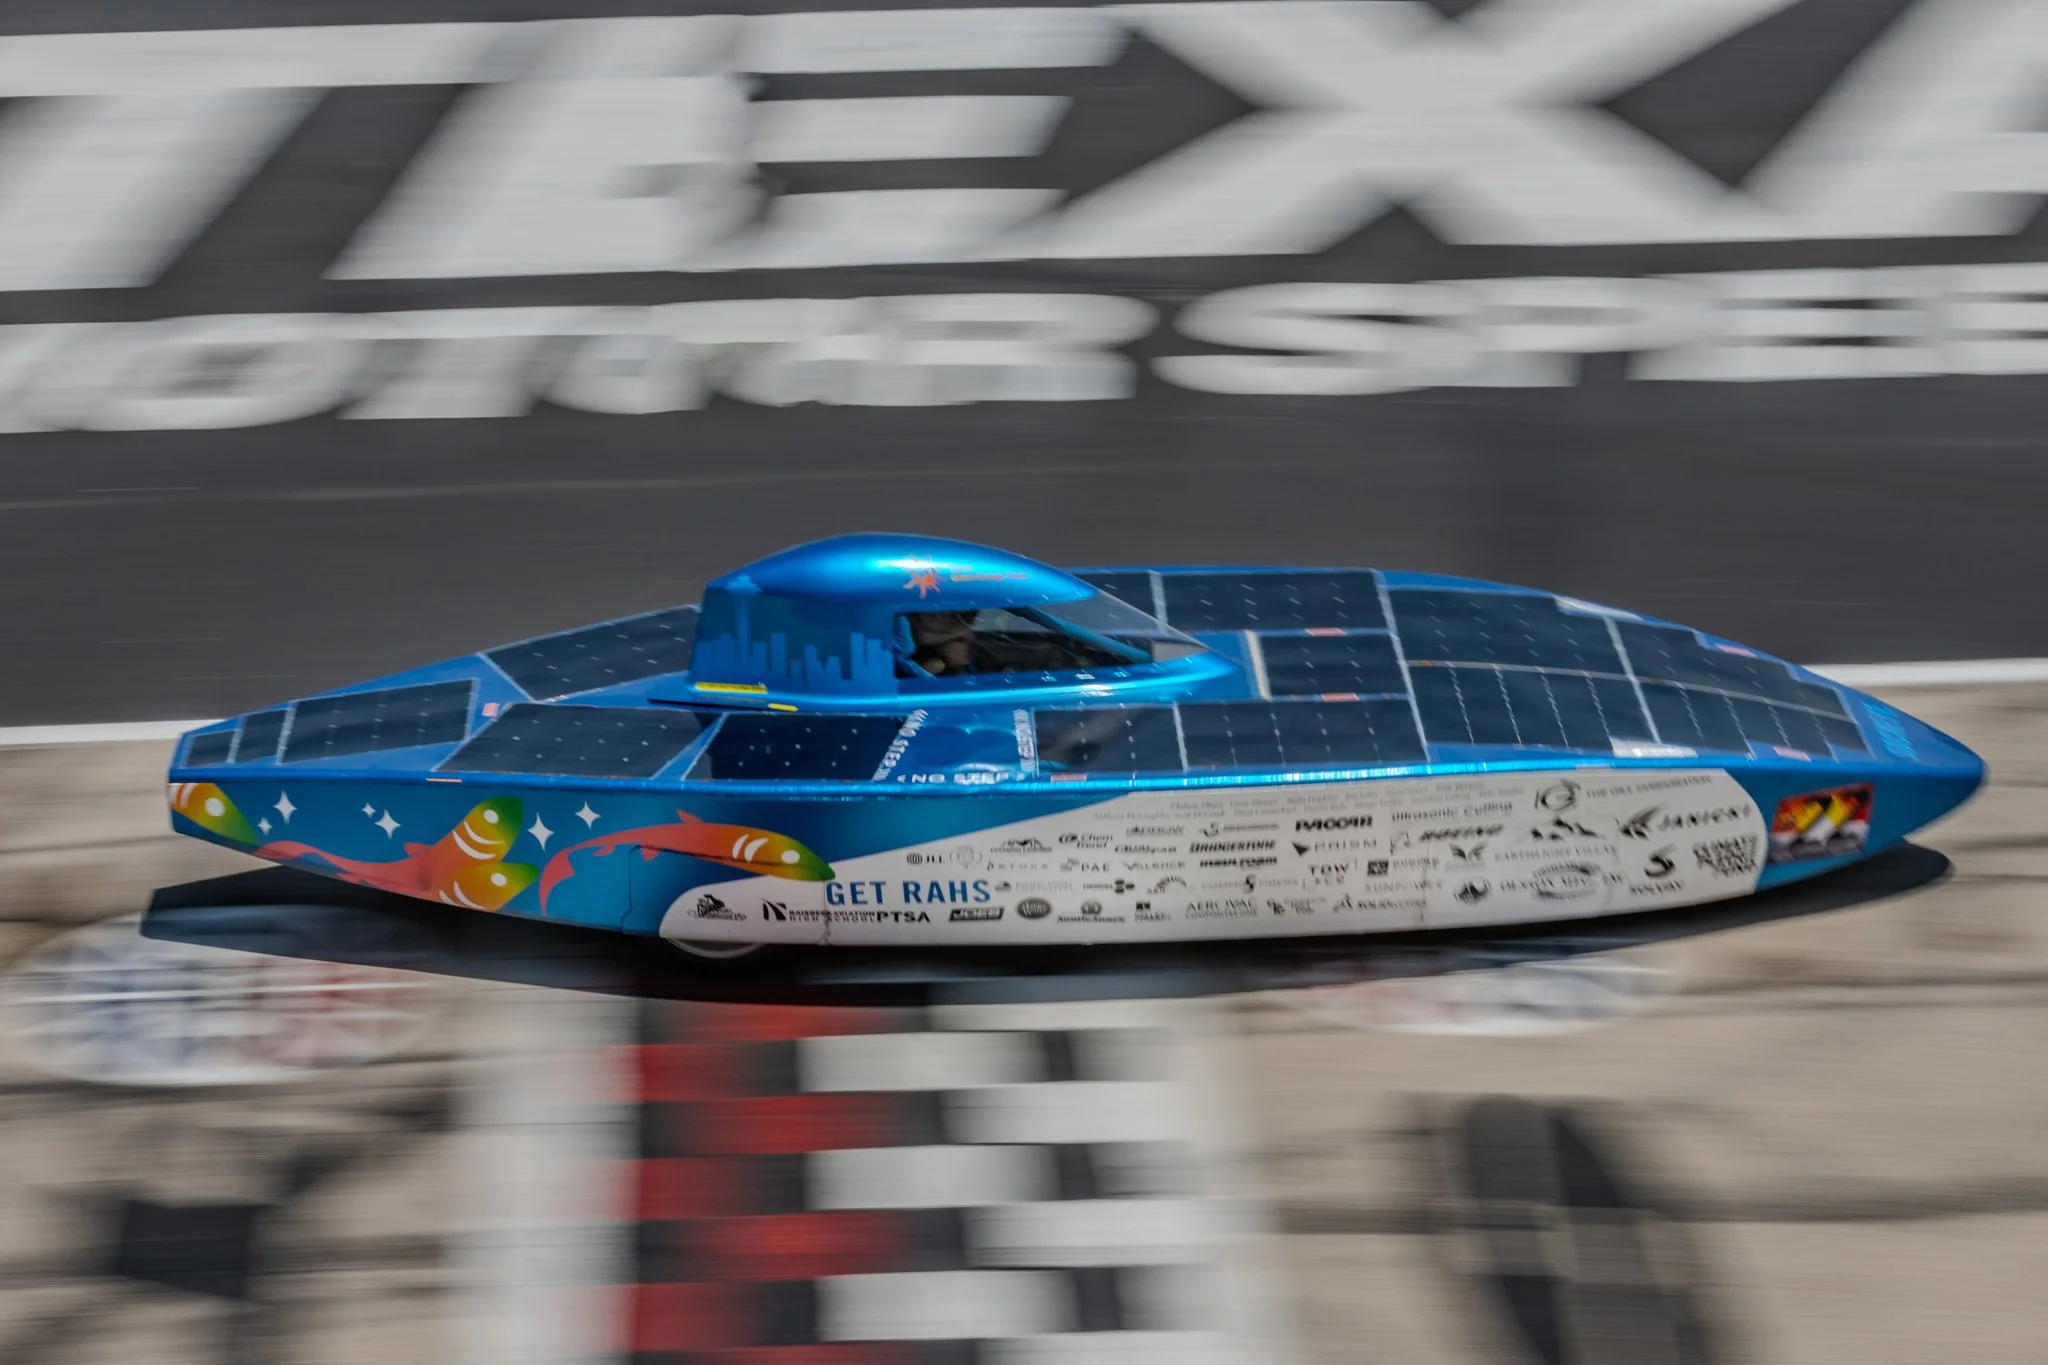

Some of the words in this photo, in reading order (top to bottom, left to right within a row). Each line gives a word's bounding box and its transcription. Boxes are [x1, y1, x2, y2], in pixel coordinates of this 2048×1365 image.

[912, 773, 946, 784] NO
[1295, 815, 1373, 832] PACCAR
[1189, 840, 1277, 854] BRIDGESTONE
[826, 881, 887, 905] GET
[903, 879, 991, 904] RAHS
[877, 911, 931, 923] PTSA
